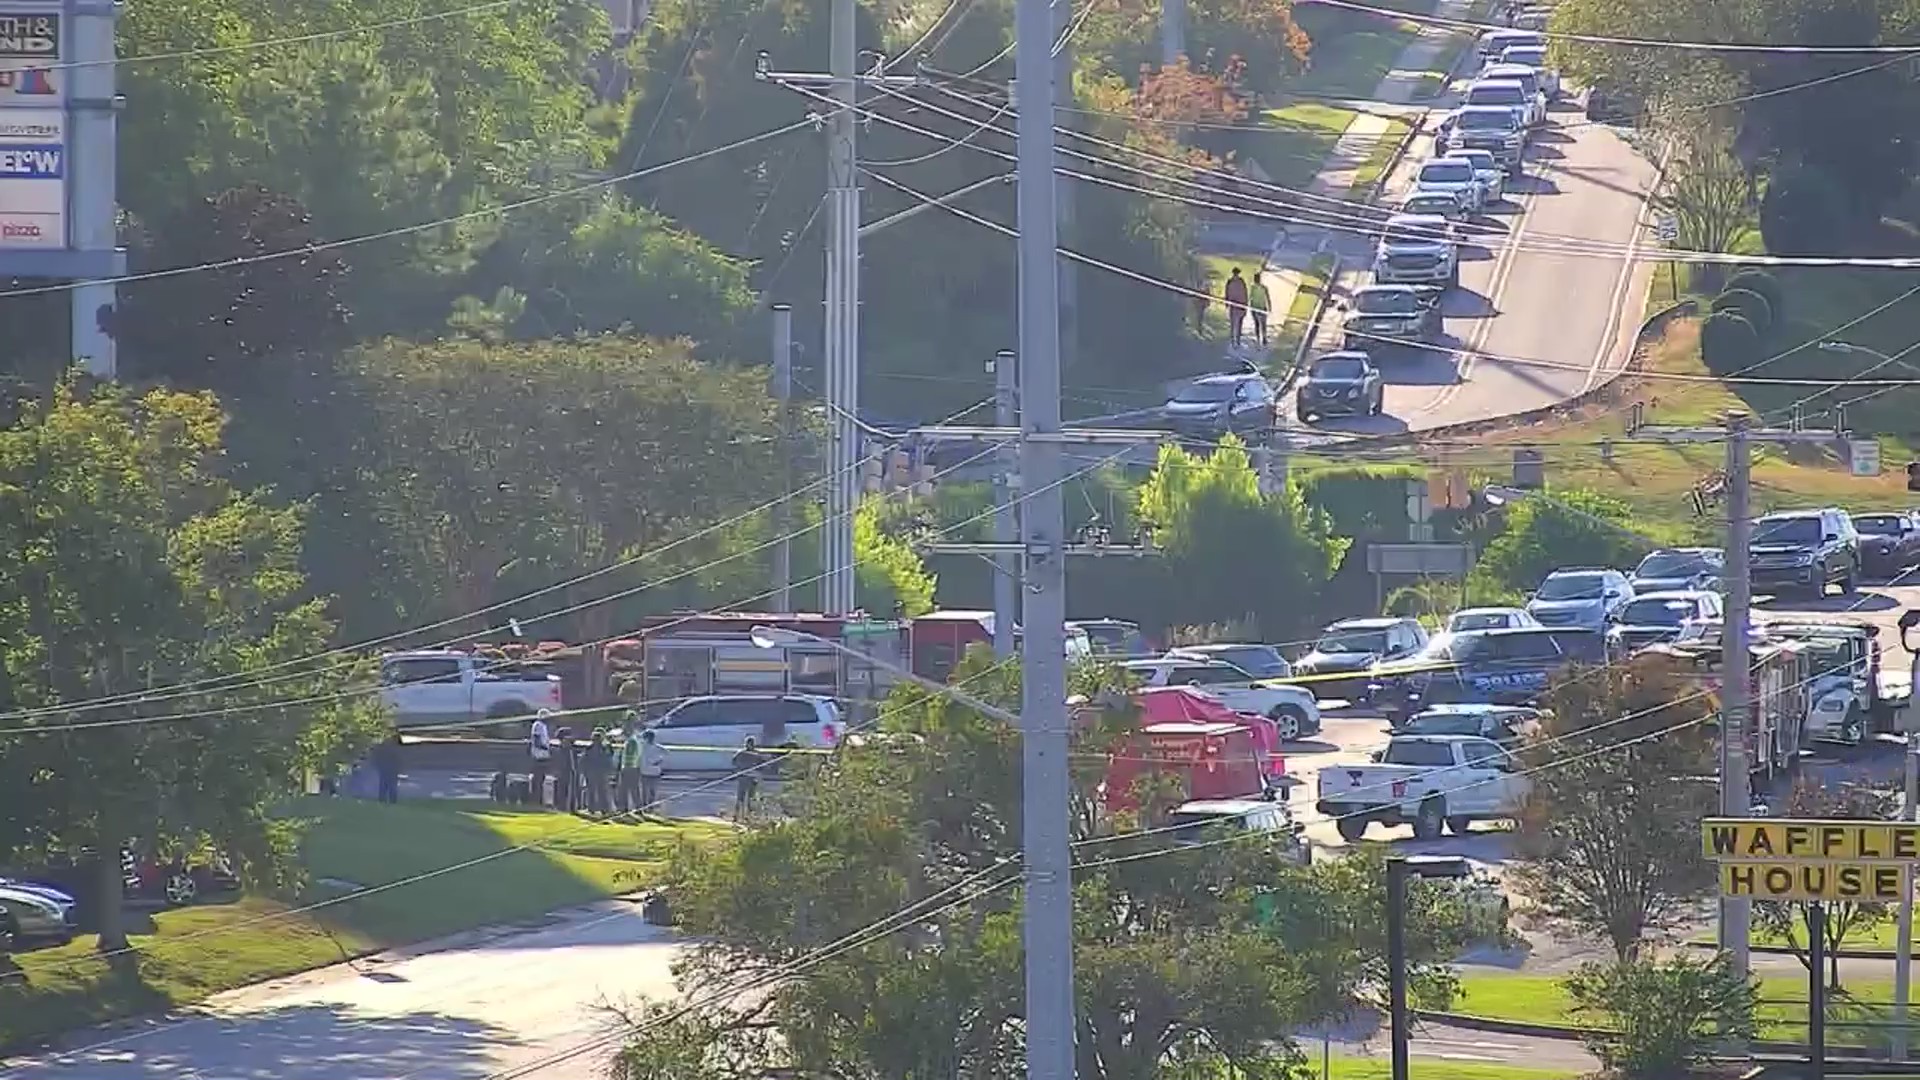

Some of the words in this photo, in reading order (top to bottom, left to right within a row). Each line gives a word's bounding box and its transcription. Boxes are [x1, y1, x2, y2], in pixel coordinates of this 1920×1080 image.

[35, 17, 54, 35] &
[1711, 827, 1917, 857] WAFFLE
[1731, 866, 1899, 895] HOUSE
